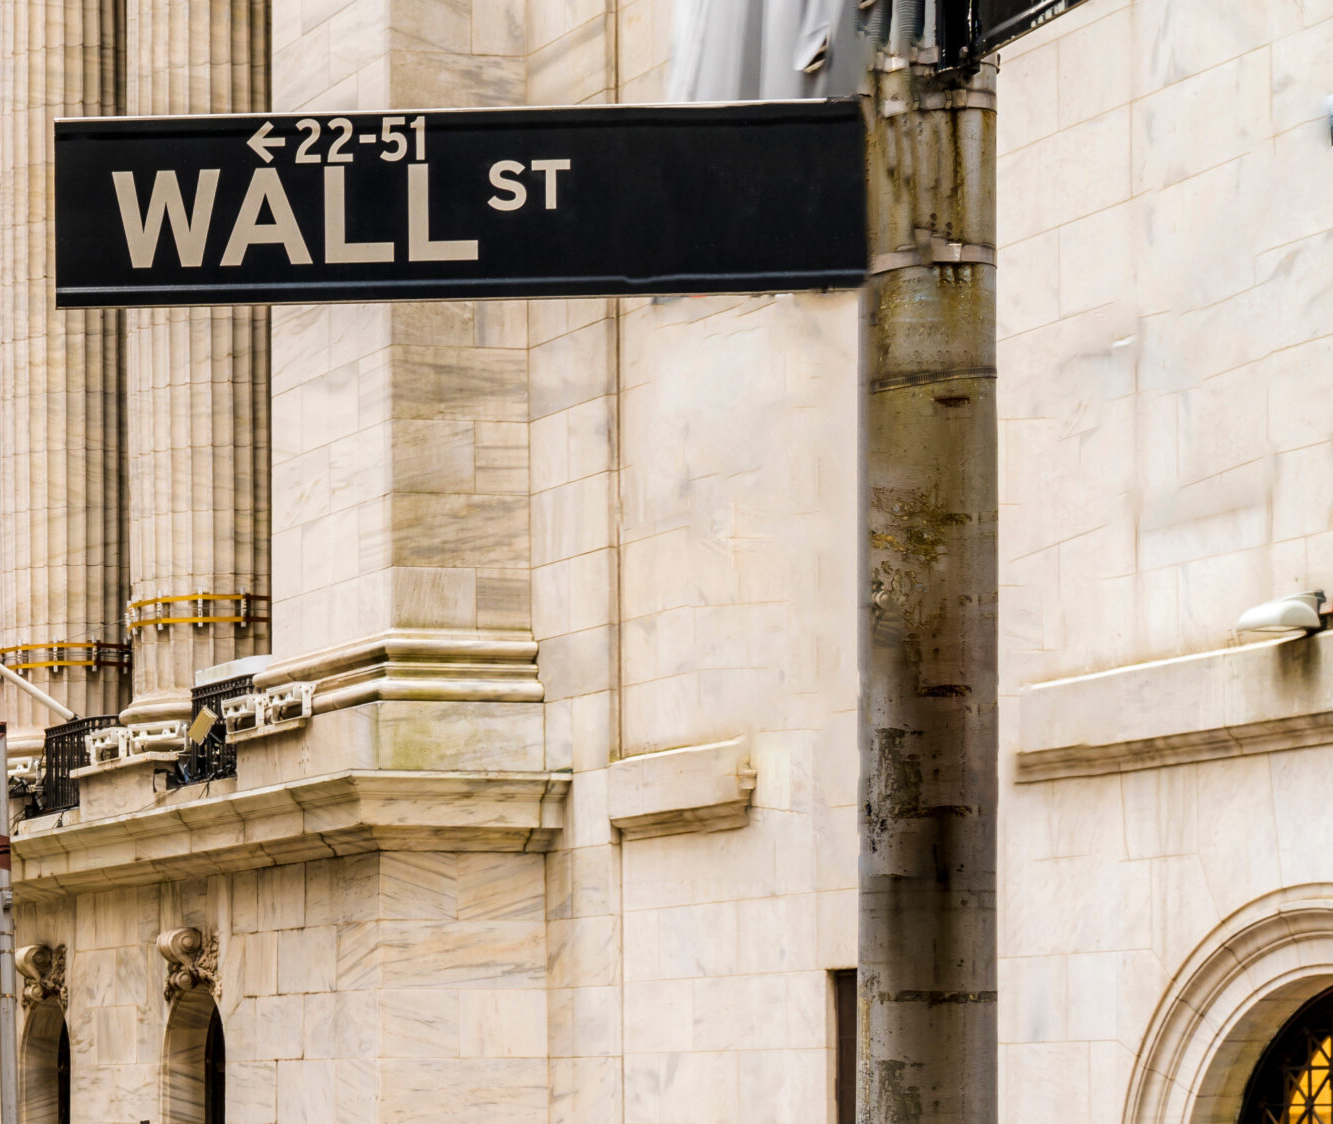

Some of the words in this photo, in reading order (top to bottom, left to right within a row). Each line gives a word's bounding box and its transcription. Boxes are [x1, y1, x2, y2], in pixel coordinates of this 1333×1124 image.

[294, 116, 427, 164] 22-51
[111, 163, 480, 269] WALL
[486, 158, 571, 212] ST
